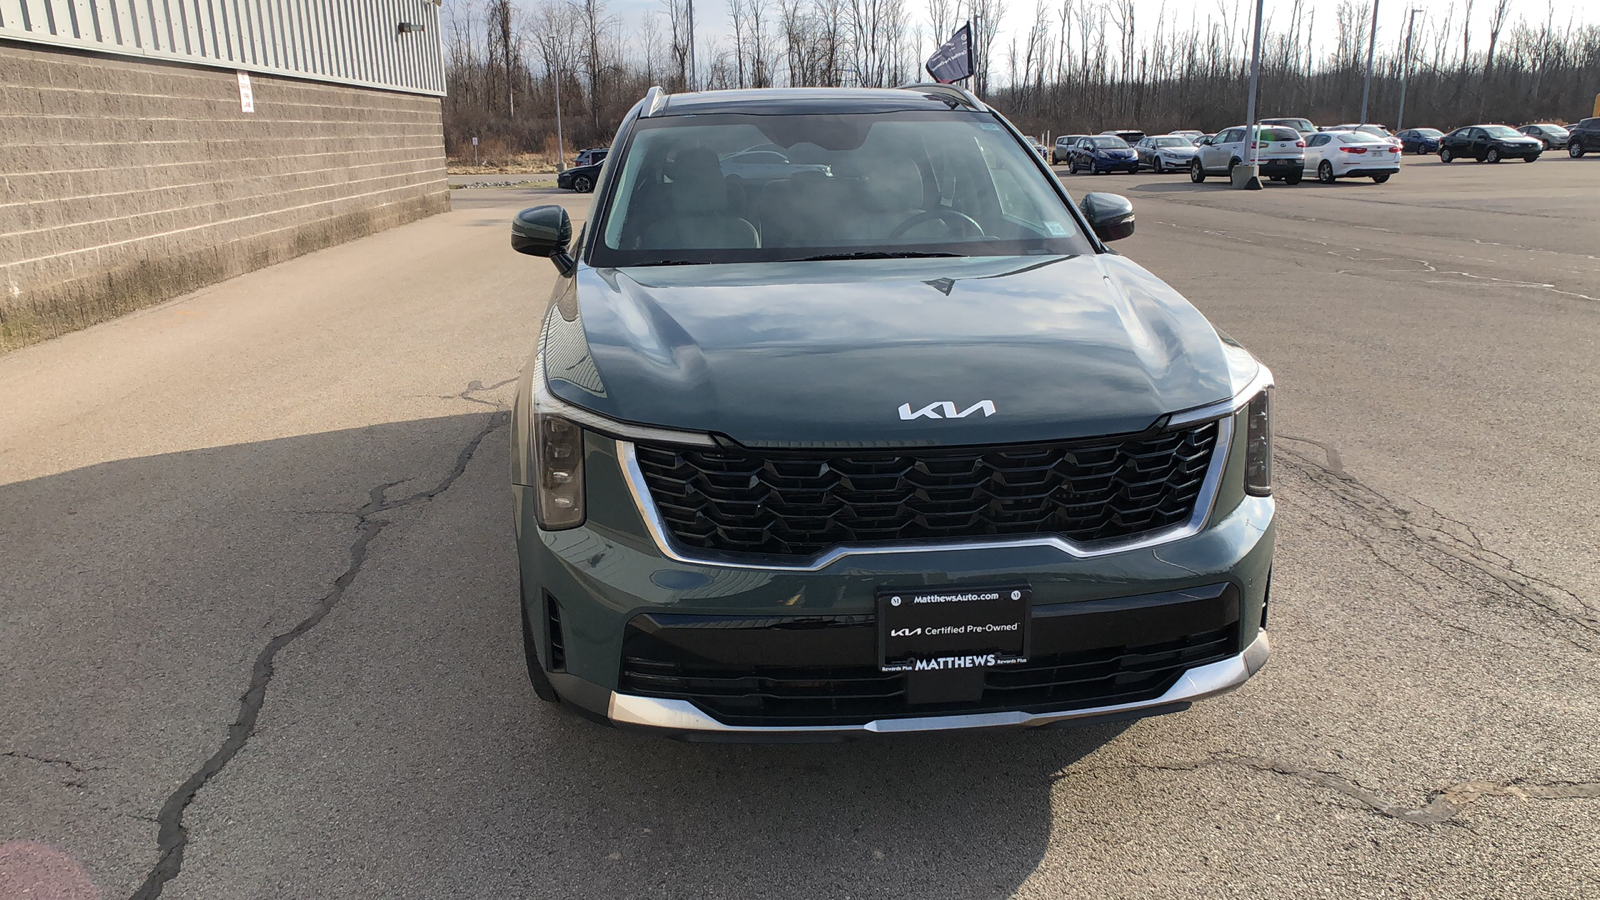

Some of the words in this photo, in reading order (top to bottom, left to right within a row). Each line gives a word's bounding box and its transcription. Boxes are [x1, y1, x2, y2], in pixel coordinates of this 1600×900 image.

[898, 400, 996, 420] KIA
[913, 593, 999, 604] MatthewsAuto.com
[890, 627, 922, 637] KIA
[925, 625, 965, 635] Certified
[914, 654, 995, 671] MATTHEWS
